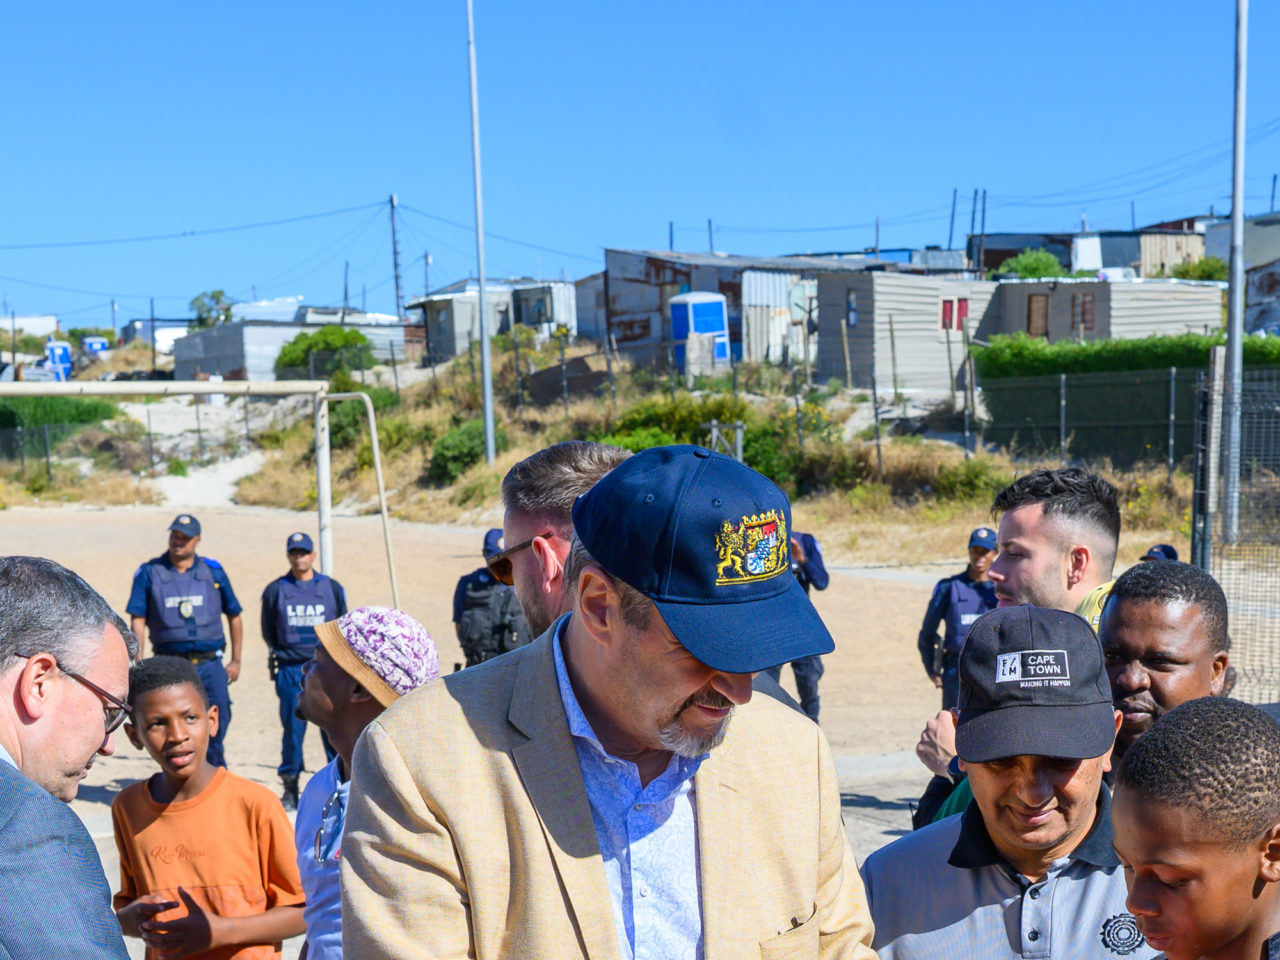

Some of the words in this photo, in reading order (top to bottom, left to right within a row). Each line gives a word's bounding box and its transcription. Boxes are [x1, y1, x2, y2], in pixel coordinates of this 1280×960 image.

[286, 604, 325, 616] LEAP
[1028, 655, 1056, 665] CAPE
[1027, 665, 1062, 675] TOWN
